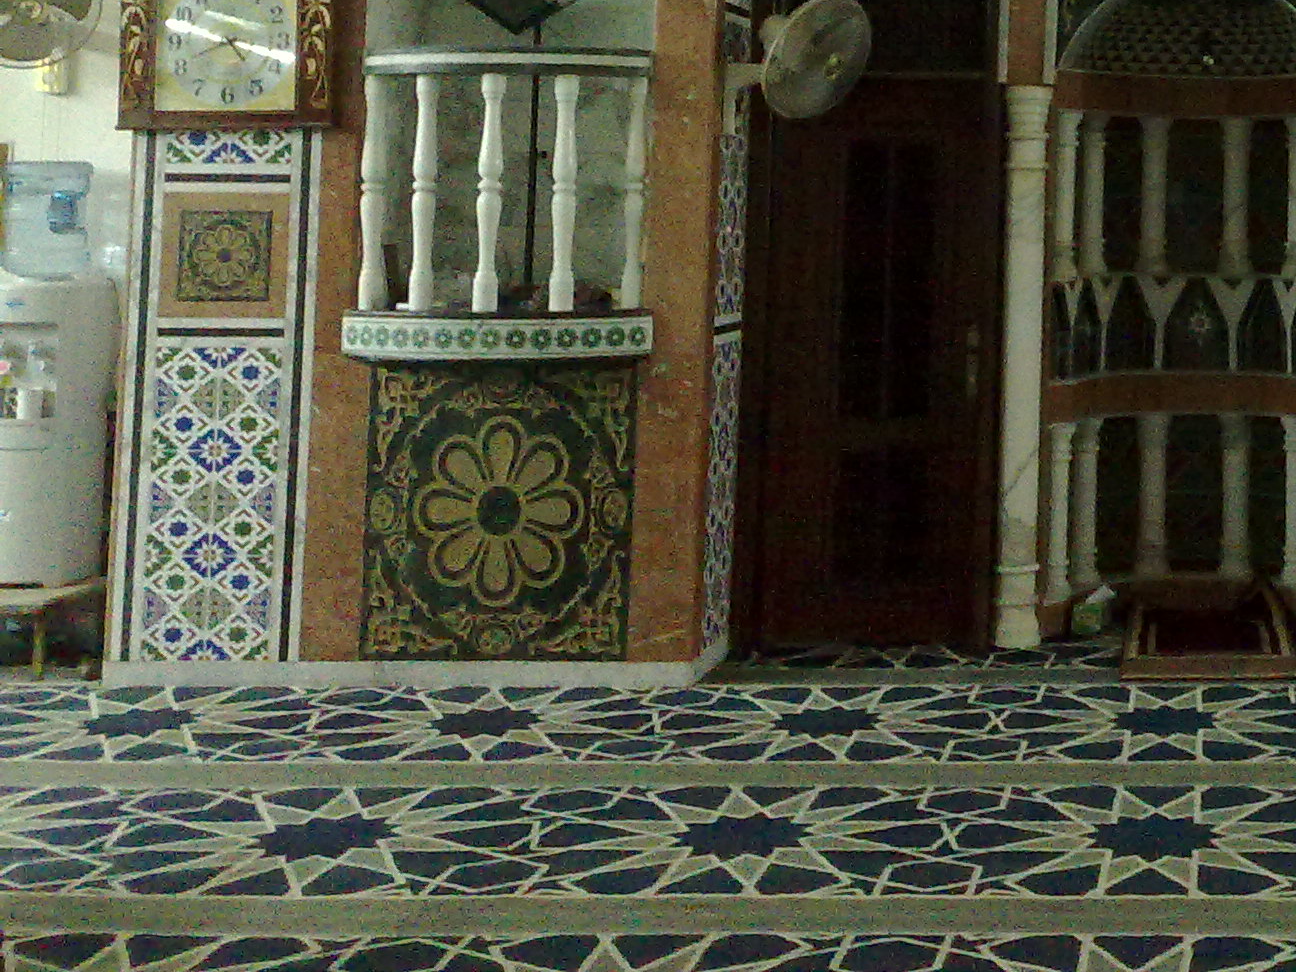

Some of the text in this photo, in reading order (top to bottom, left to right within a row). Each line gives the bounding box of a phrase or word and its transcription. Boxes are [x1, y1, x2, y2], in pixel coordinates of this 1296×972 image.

[270, 6, 284, 24] 2
[168, 33, 183, 50] 9
[276, 32, 290, 50] 3
[174, 59, 188, 76] 8
[193, 79, 207, 97] 7
[220, 87, 234, 104] 6
[249, 79, 264, 96] 5
